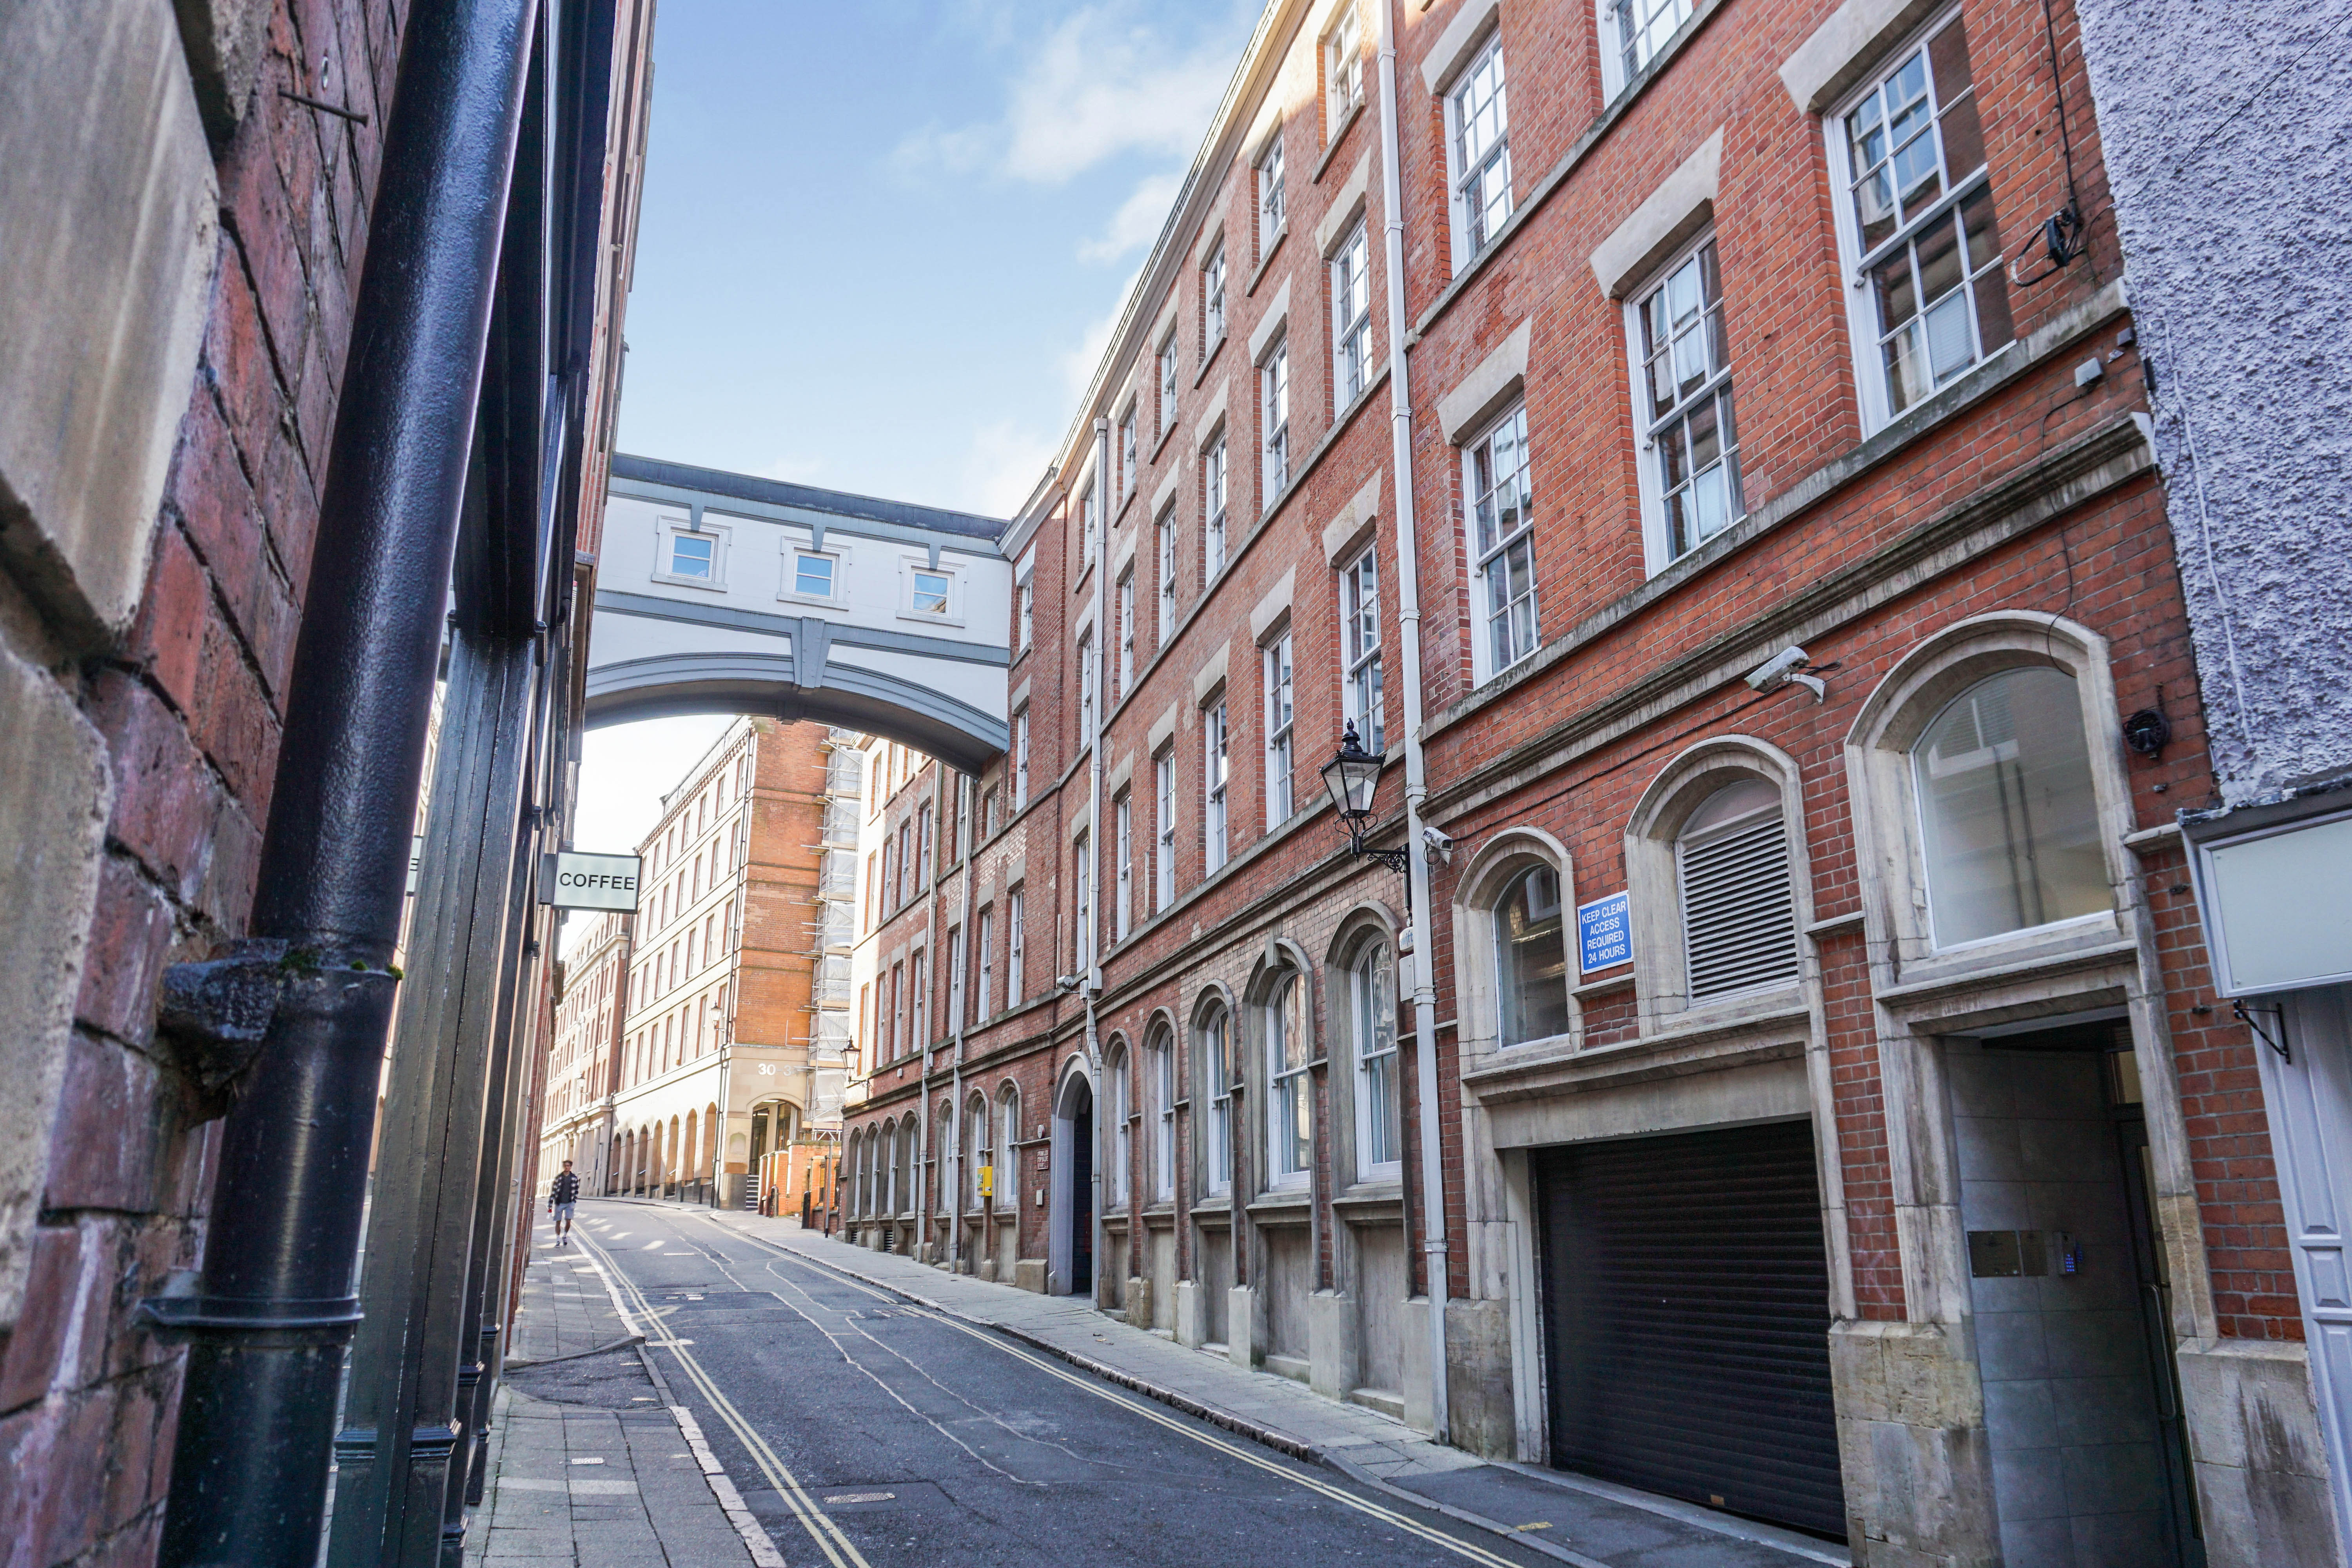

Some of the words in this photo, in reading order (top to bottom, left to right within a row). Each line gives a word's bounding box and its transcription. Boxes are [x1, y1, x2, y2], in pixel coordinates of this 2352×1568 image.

[559, 873, 635, 890] COFFEE
[1582, 909, 1600, 924] KEEP
[1602, 901, 1626, 918] CLEAR
[1590, 917, 1619, 936] ACCESS
[1587, 930, 1624, 950] REQUIRED
[1588, 952, 1597, 964] 24
[1599, 944, 1625, 960] HOURS
